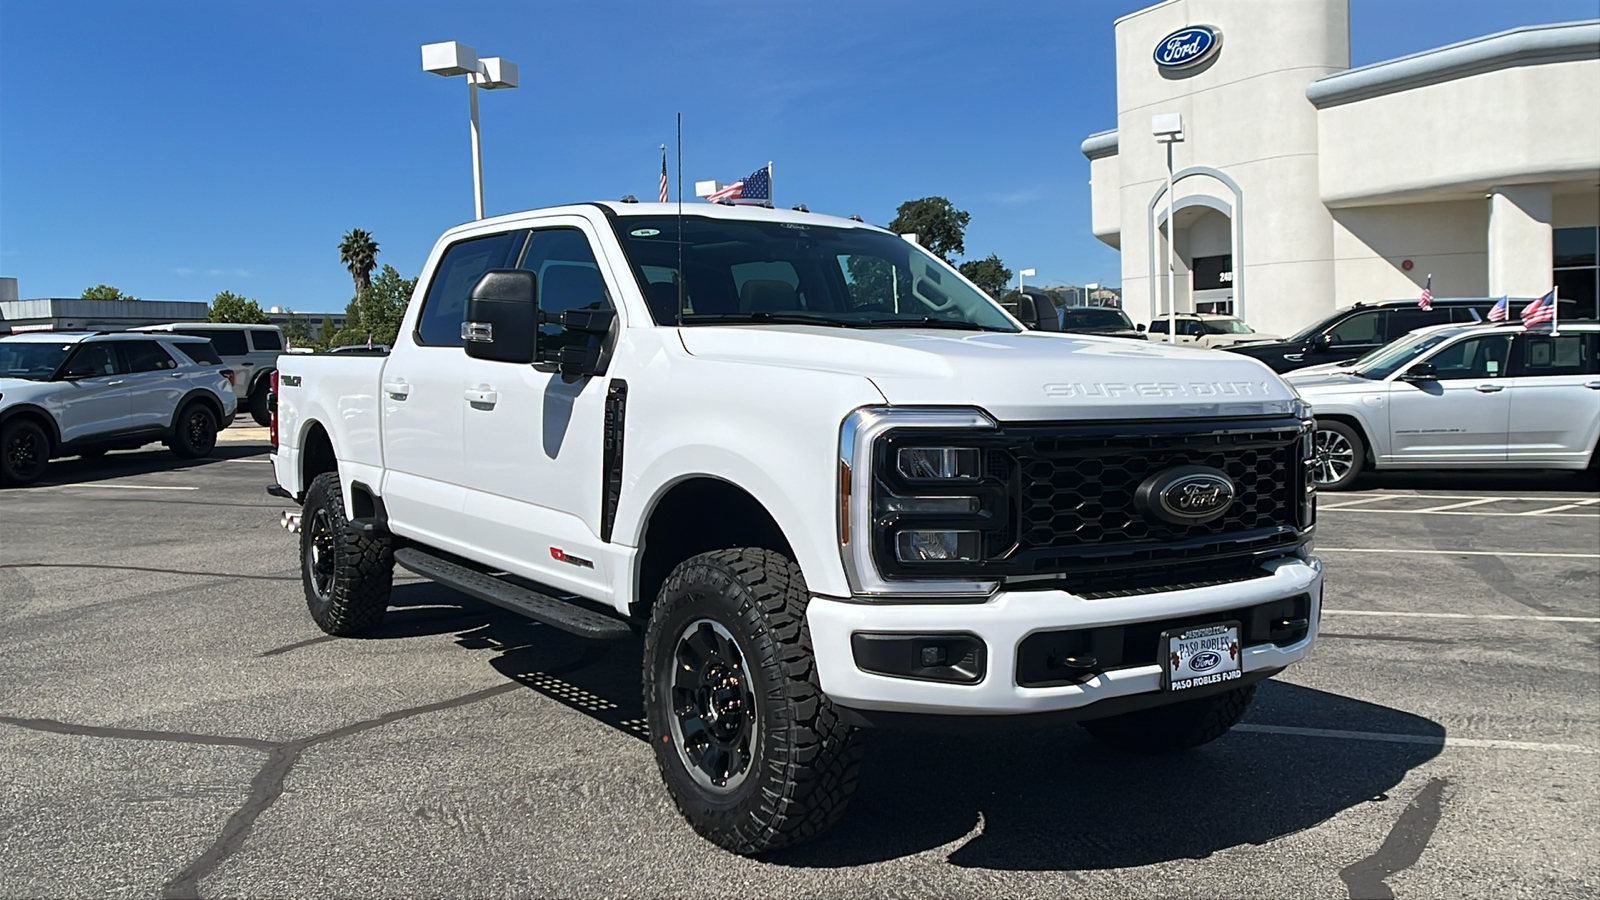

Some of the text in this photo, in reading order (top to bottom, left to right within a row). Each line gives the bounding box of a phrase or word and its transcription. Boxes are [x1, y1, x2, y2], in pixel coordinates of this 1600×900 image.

[1163, 33, 1202, 62] Ford
[1042, 381, 1270, 398] SUPER DUTY
[1180, 483, 1220, 508] Ford
[1179, 635, 1231, 660] PASO ROBLES
[1194, 655, 1216, 668] Ford
[1171, 670, 1242, 691] PASO ROBLES FORD
